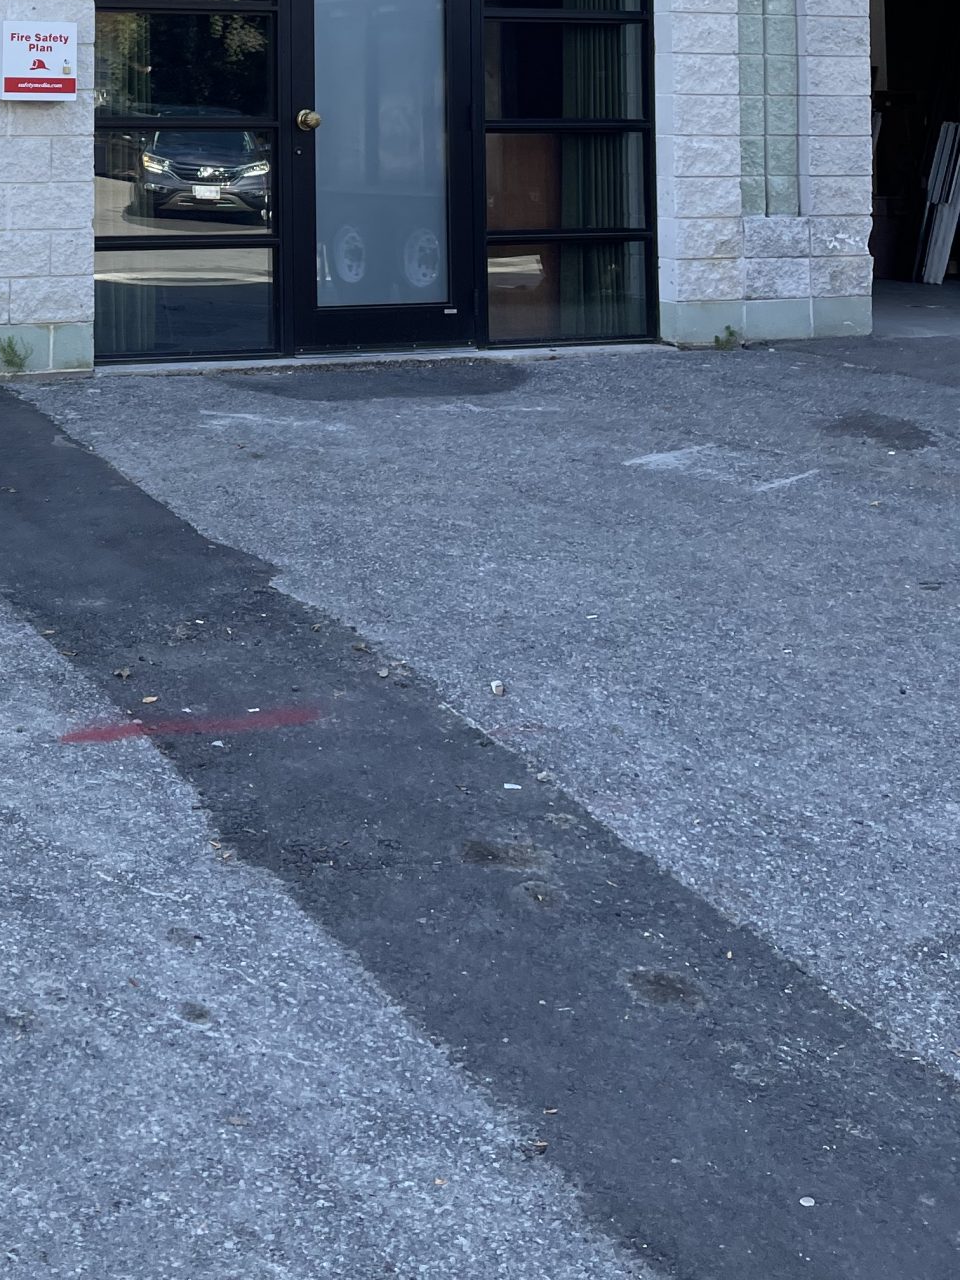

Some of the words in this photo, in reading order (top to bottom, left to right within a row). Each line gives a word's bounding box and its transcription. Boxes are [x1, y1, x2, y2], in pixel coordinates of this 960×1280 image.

[10, 32, 31, 41] Fire
[35, 33, 69, 44] Safety
[29, 43, 53, 52] Plan
